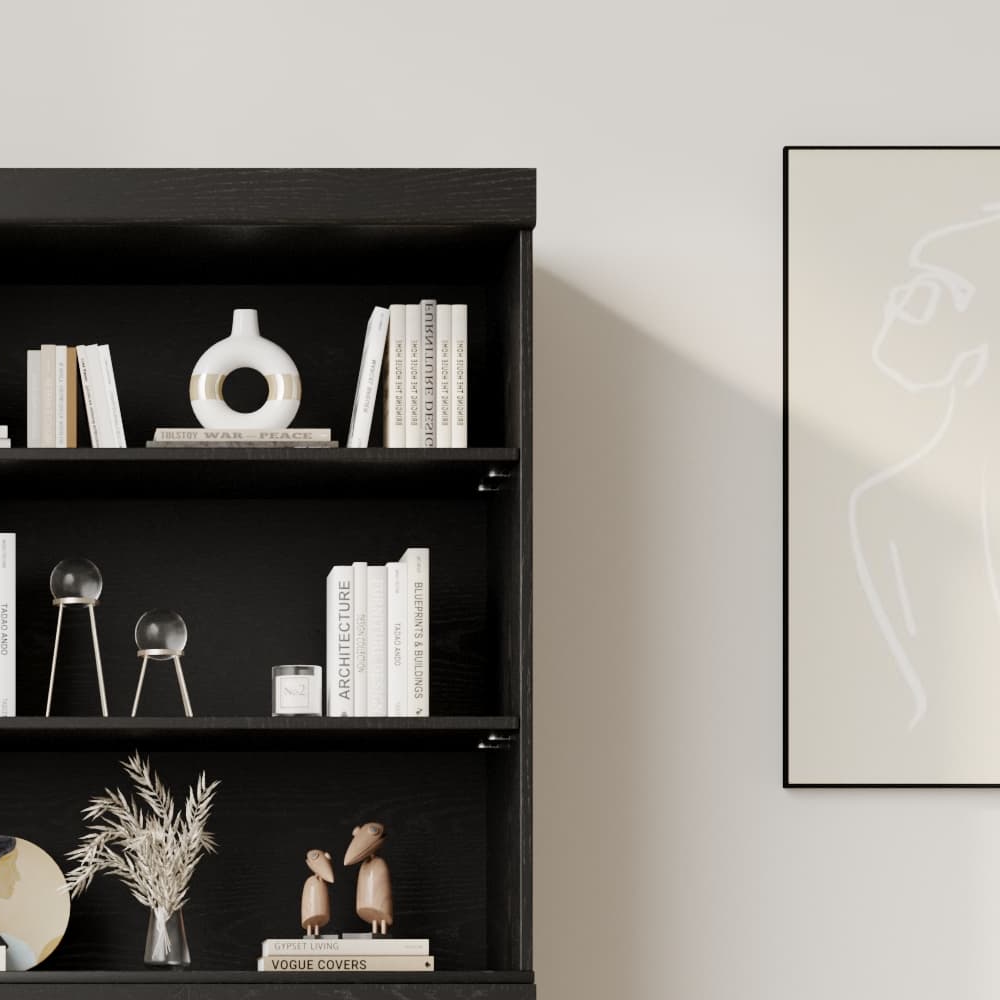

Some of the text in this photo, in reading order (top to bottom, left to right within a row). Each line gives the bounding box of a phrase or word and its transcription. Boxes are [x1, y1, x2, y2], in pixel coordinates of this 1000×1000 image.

[203, 432, 243, 440] WAR
[259, 432, 313, 440] PEACE
[414, 582, 423, 638] BLUEPRINTS
[338, 581, 350, 700] ARCHITECTURE
[414, 650, 423, 698] BUILDINGS
[274, 942, 340, 950] GYPSET LIVING
[272, 960, 367, 970] VOGUE COVERS
